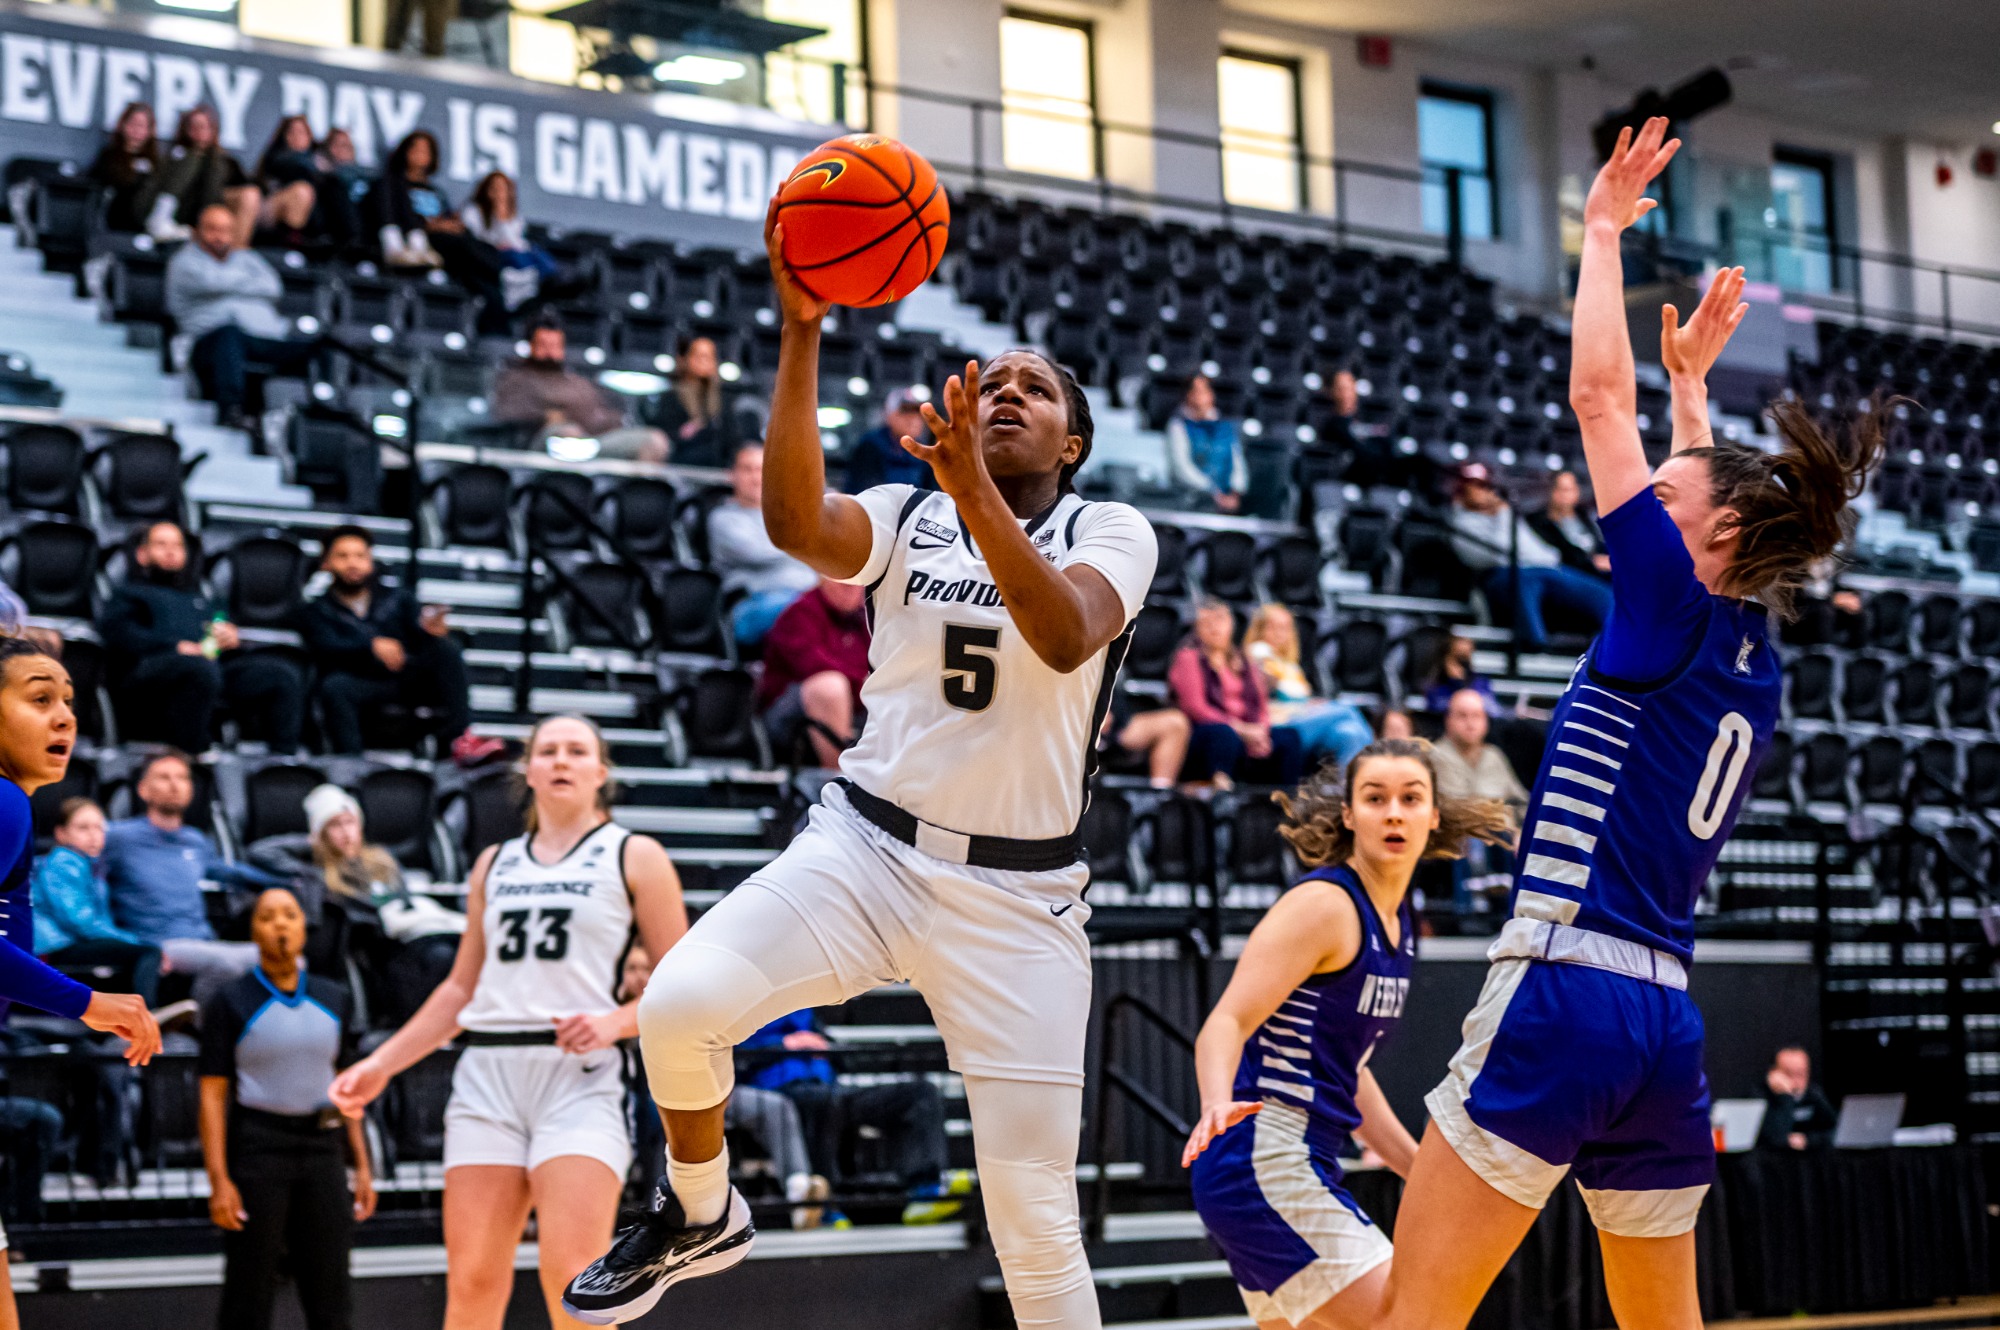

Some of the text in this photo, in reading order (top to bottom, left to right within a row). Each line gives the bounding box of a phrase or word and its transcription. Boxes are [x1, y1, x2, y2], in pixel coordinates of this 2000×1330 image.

[2, 31, 261, 150] EVERY
[446, 98, 519, 182] IS
[535, 112, 809, 221] GAMED
[903, 570, 1006, 606] PROVID
[940, 620, 1002, 714] 5
[1687, 711, 1754, 840] 0
[497, 908, 573, 962] 33
